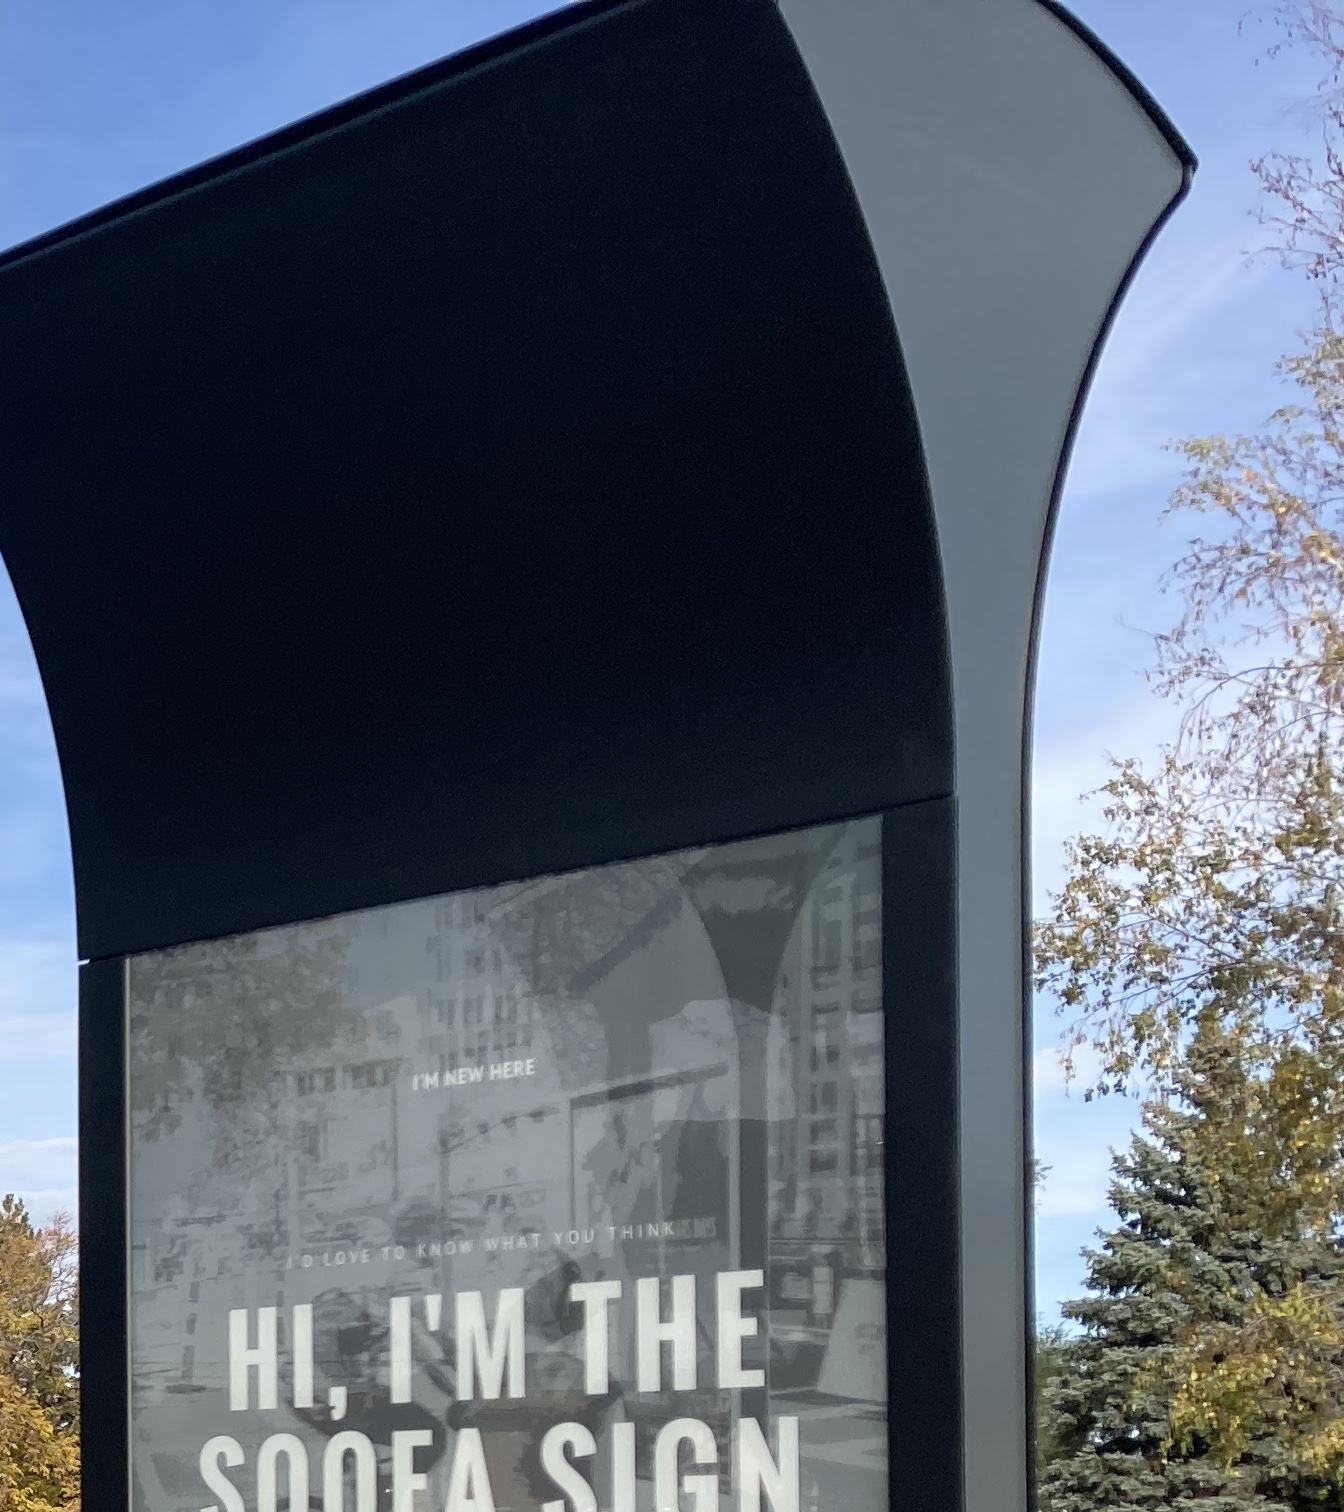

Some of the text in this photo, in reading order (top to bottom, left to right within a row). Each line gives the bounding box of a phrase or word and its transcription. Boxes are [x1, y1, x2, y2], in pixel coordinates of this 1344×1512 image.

[412, 1058, 535, 1091] I'M NEW HERE
[323, 1248, 370, 1267] LOVE
[380, 1245, 405, 1262] TO
[416, 1239, 473, 1259] KNOW
[484, 1233, 542, 1253] WHAT
[552, 1229, 594, 1248] YOU
[608, 1222, 674, 1243] THINK
[228, 1269, 766, 1421] HI, I'M THE
